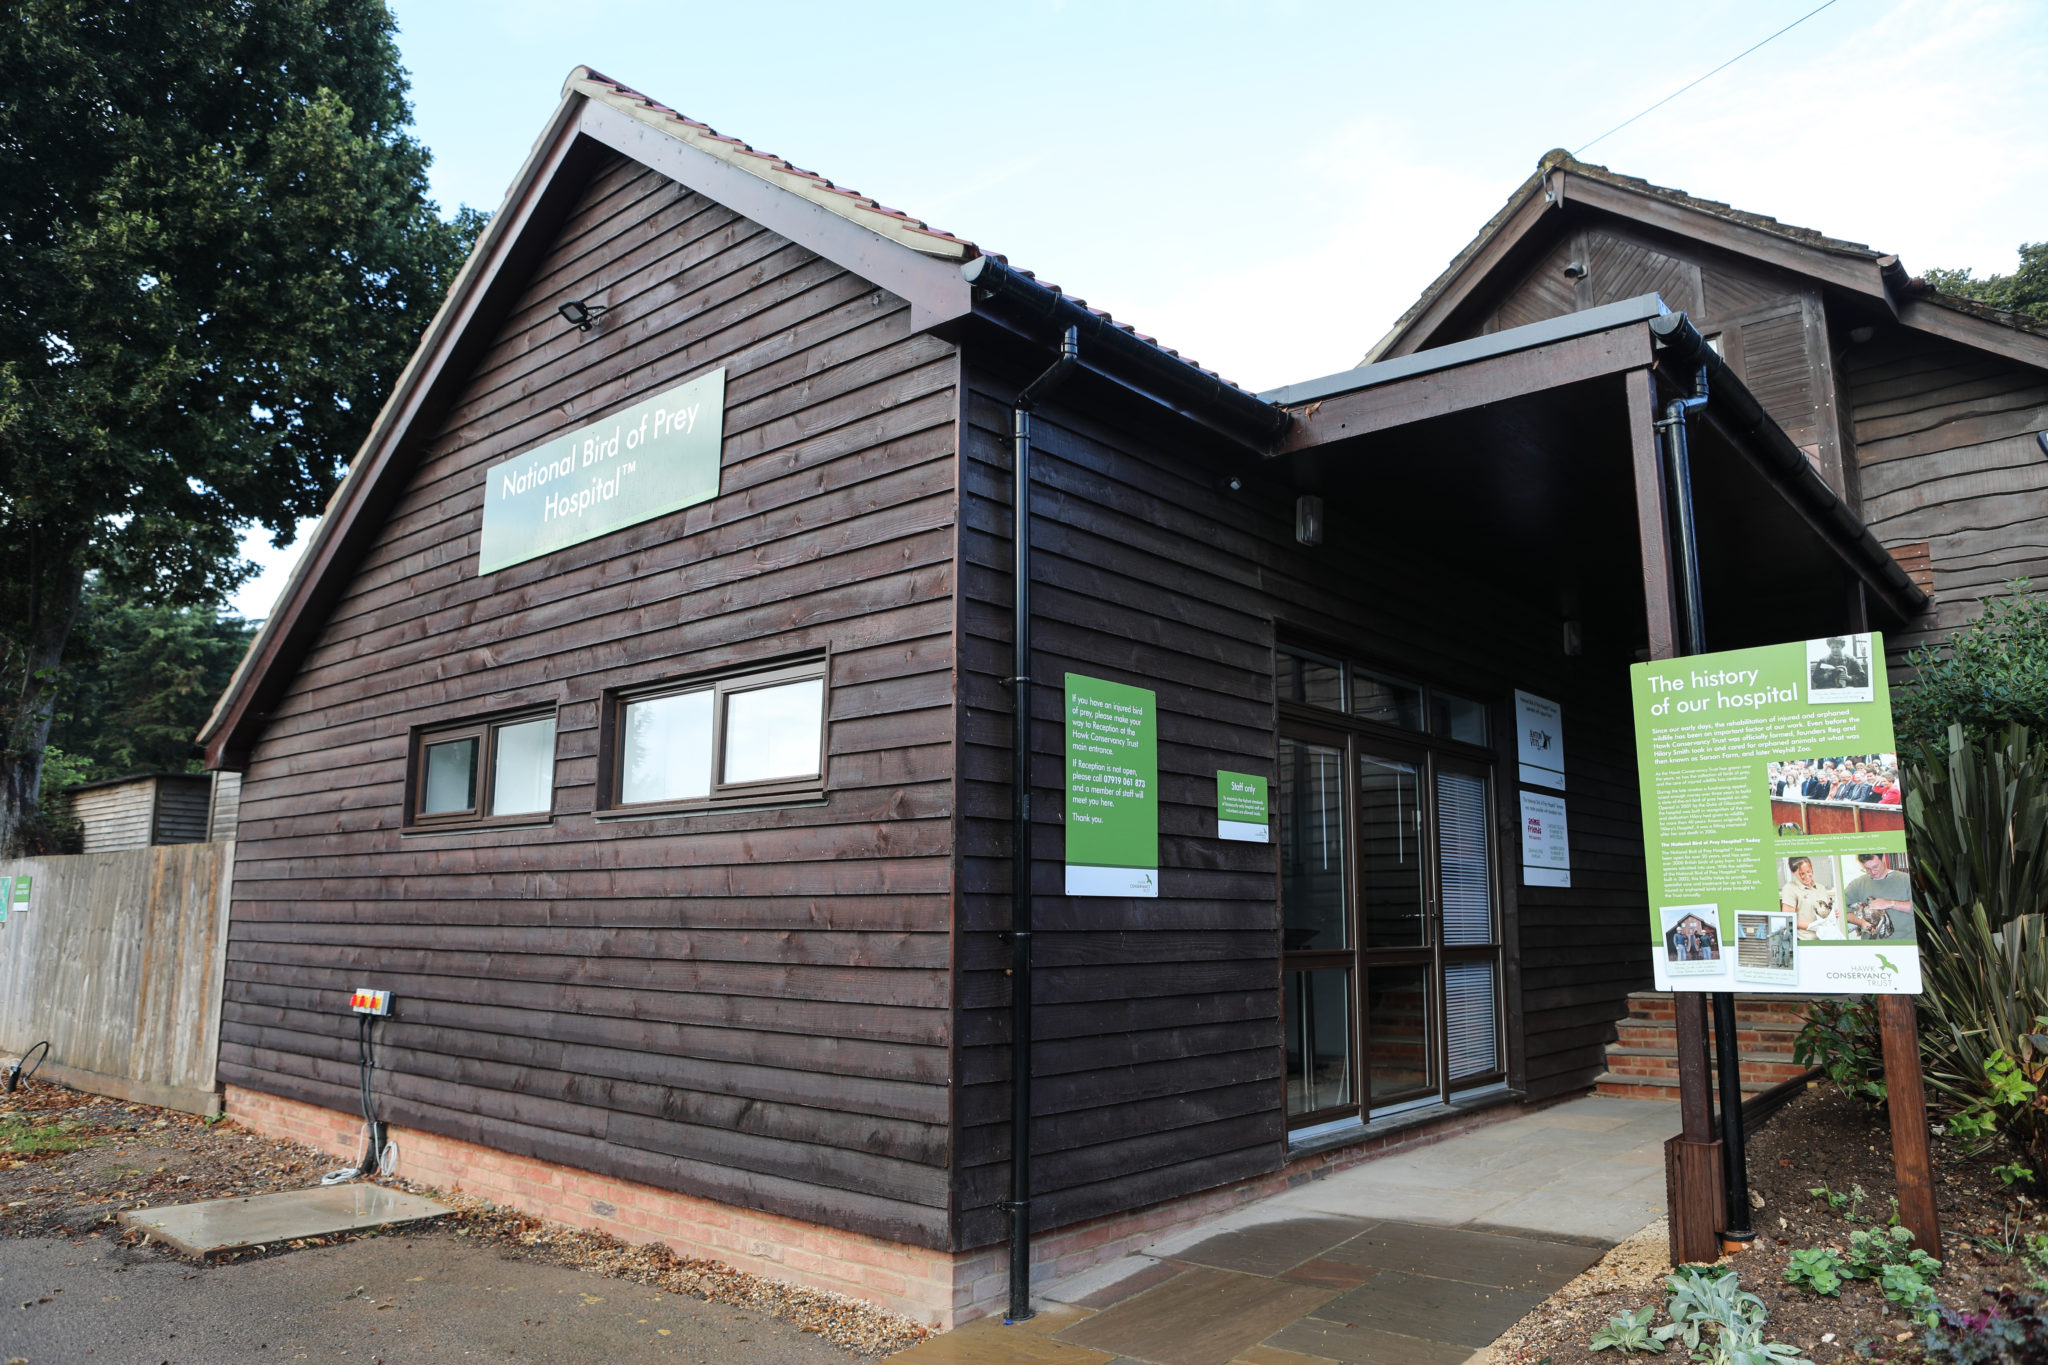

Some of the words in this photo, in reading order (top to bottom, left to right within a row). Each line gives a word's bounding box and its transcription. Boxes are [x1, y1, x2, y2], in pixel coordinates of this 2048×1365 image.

[502, 444, 576, 500] National
[582, 426, 620, 468] Bird
[627, 414, 648, 449] of
[654, 403, 700, 439] Prey
[1648, 675, 1684, 694] The
[1691, 670, 1759, 688] history
[1090, 697, 1103, 707] have
[1114, 702, 1131, 712] injured
[1133, 705, 1142, 715] bird
[1651, 697, 1670, 716] of
[1677, 698, 1710, 714] our
[1717, 682, 1798, 710] hospital
[1080, 710, 1093, 718] prey,
[1095, 711, 1112, 720] please
[1114, 715, 1128, 724] make
[1727, 718, 1767, 726] rehabilitation
[1778, 714, 1800, 722] injured
[1817, 709, 1849, 718] orphaned
[1072, 720, 1084, 728] way
[1093, 721, 1118, 732] Reception
[1127, 728, 1135, 736] the
[1072, 730, 1089, 739] Hawk
[1091, 732, 1125, 747] Conservancy
[1126, 739, 1138, 747] Trust
[1672, 739, 1710, 747] Conservancy
[1073, 742, 1087, 751] main
[1089, 746, 1114, 755] entrance.
[1073, 759, 1076, 767] If
[1078, 760, 1105, 771] Reception
[1073, 771, 1091, 781] please
[1093, 774, 1102, 782] call
[1104, 775, 1121, 784] 07919
[1135, 779, 1145, 788] 873
[1091, 786, 1114, 795] member
[1232, 781, 1243, 791] Staff
[1245, 784, 1255, 795] only
[1101, 798, 1114, 807] here.
[1072, 813, 1090, 822] Thank
